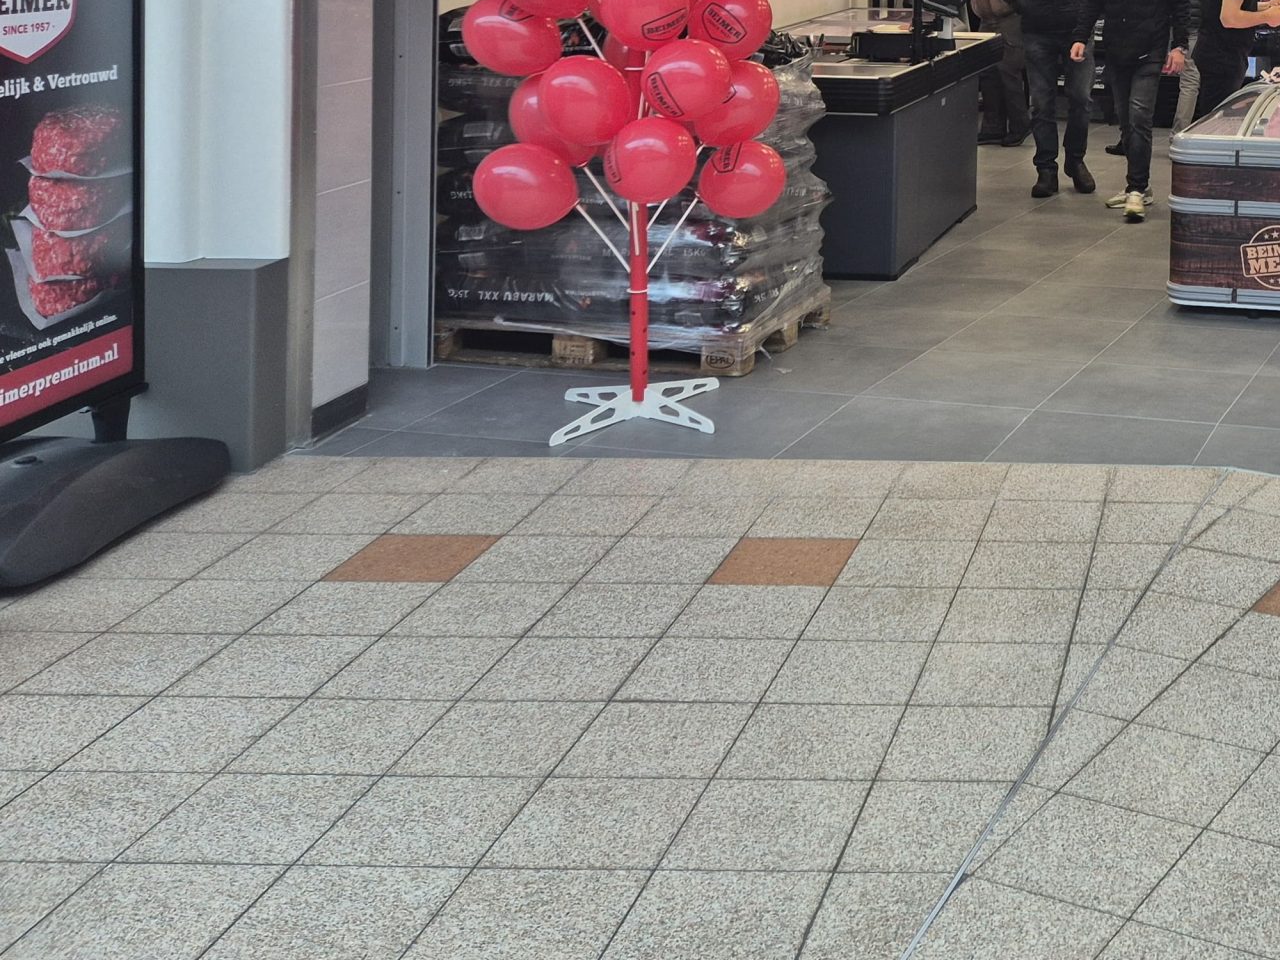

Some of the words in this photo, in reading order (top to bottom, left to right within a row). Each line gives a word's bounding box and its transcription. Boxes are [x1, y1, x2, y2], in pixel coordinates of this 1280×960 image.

[2, 24, 29, 36] SINCE
[30, 22, 51, 32] 1957
[707, 7, 743, 39] BEIMER
[0, 77, 31, 100] elijk
[33, 76, 46, 92] &
[47, 64, 119, 90] Vertrouwd
[477, 290, 500, 301] XXL
[502, 291, 554, 302] MARABU
[38, 337, 52, 350] ook
[52, 321, 95, 346] gemakkelijk
[0, 343, 119, 407] imerpremium.nl
